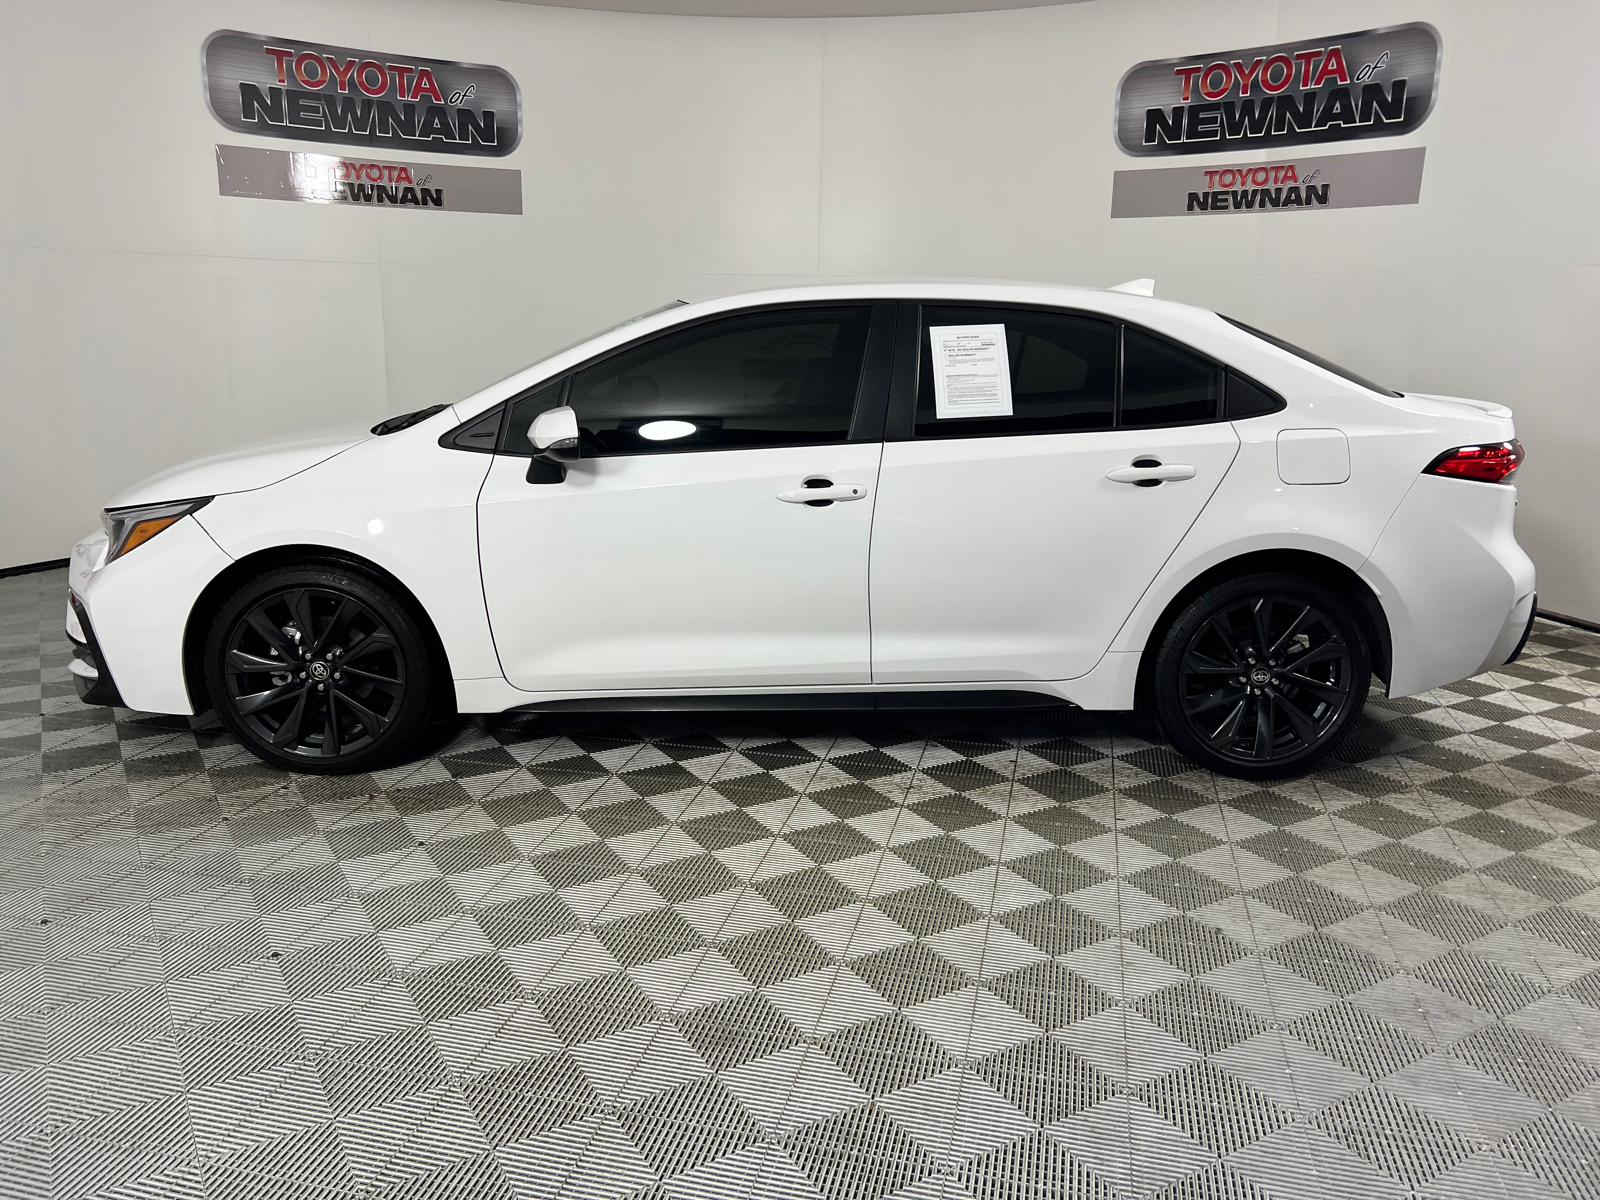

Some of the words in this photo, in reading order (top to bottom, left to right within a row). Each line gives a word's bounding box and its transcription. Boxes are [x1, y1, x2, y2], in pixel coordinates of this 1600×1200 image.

[264, 46, 444, 104] TOYOTA
[448, 84, 475, 106] of
[1175, 45, 1350, 103] TOYOTA
[1354, 51, 1390, 83] of
[238, 82, 498, 146] NEWNAN
[1142, 77, 1409, 146] NEWNAN
[334, 161, 413, 185] OYOTA
[416, 174, 433, 187] of
[334, 182, 444, 209] EWNAN
[1203, 164, 1299, 189] TOYOTA
[1302, 169, 1320, 185] of
[1186, 182, 1331, 213] NEWNAN
